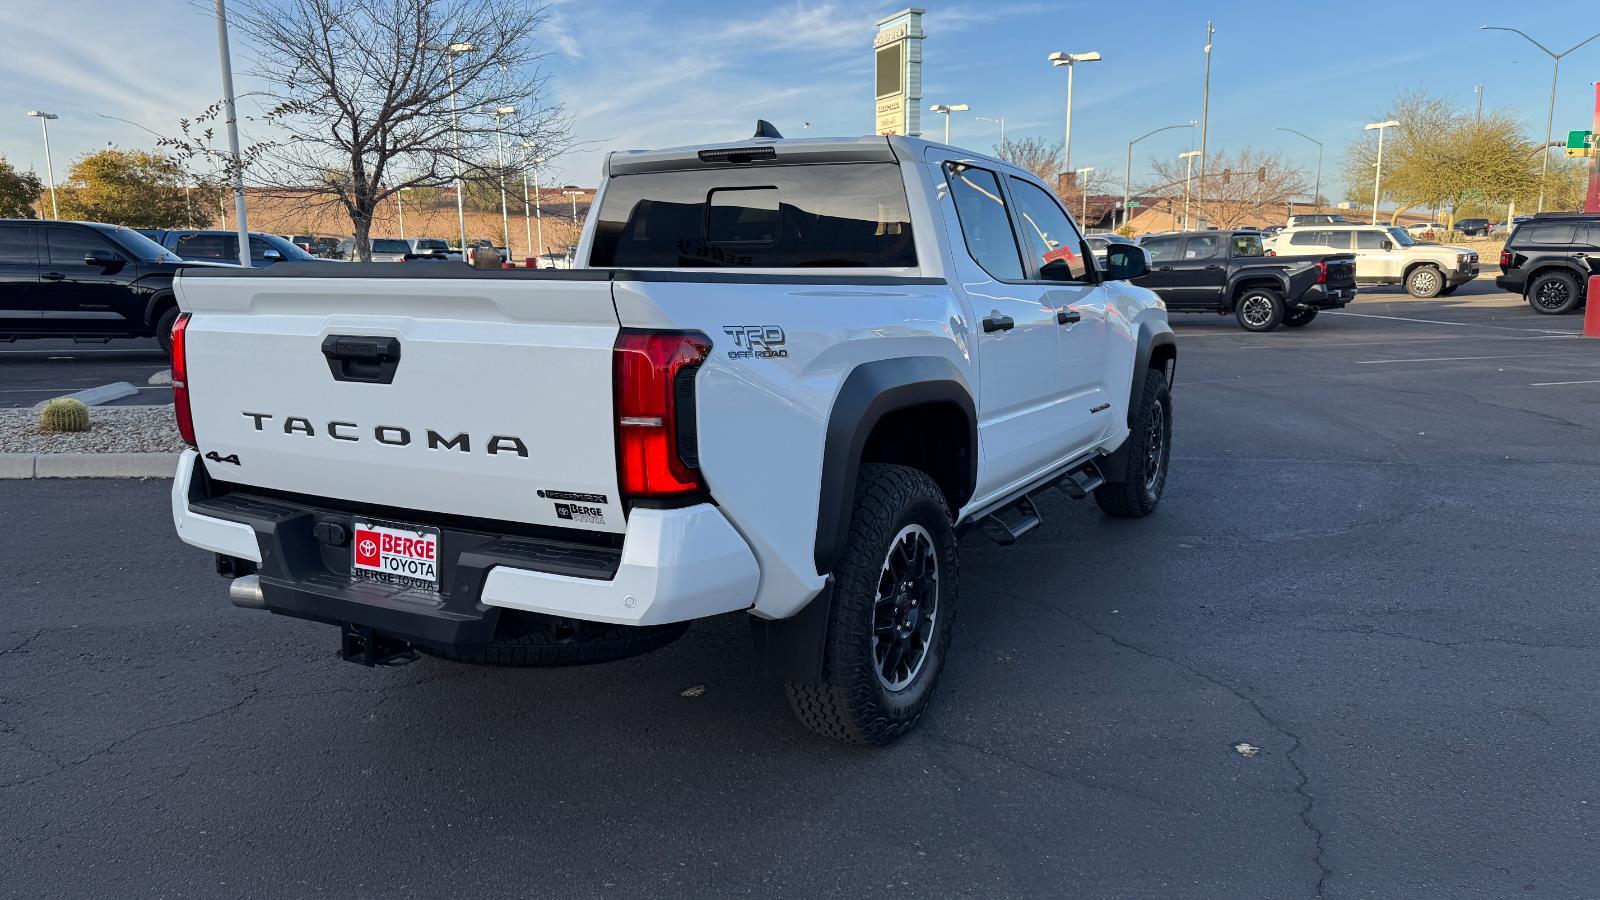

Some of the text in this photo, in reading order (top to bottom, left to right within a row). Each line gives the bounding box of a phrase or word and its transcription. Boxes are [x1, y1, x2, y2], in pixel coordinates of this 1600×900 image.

[722, 325, 786, 351] TRD
[728, 350, 788, 360] OFF ROAD
[241, 411, 529, 458] TACOMA
[569, 503, 603, 517] BERGE
[382, 533, 435, 559] BERGE
[381, 556, 435, 577] TOYOTA
[355, 567, 434, 591] BERGE TOYOTA
